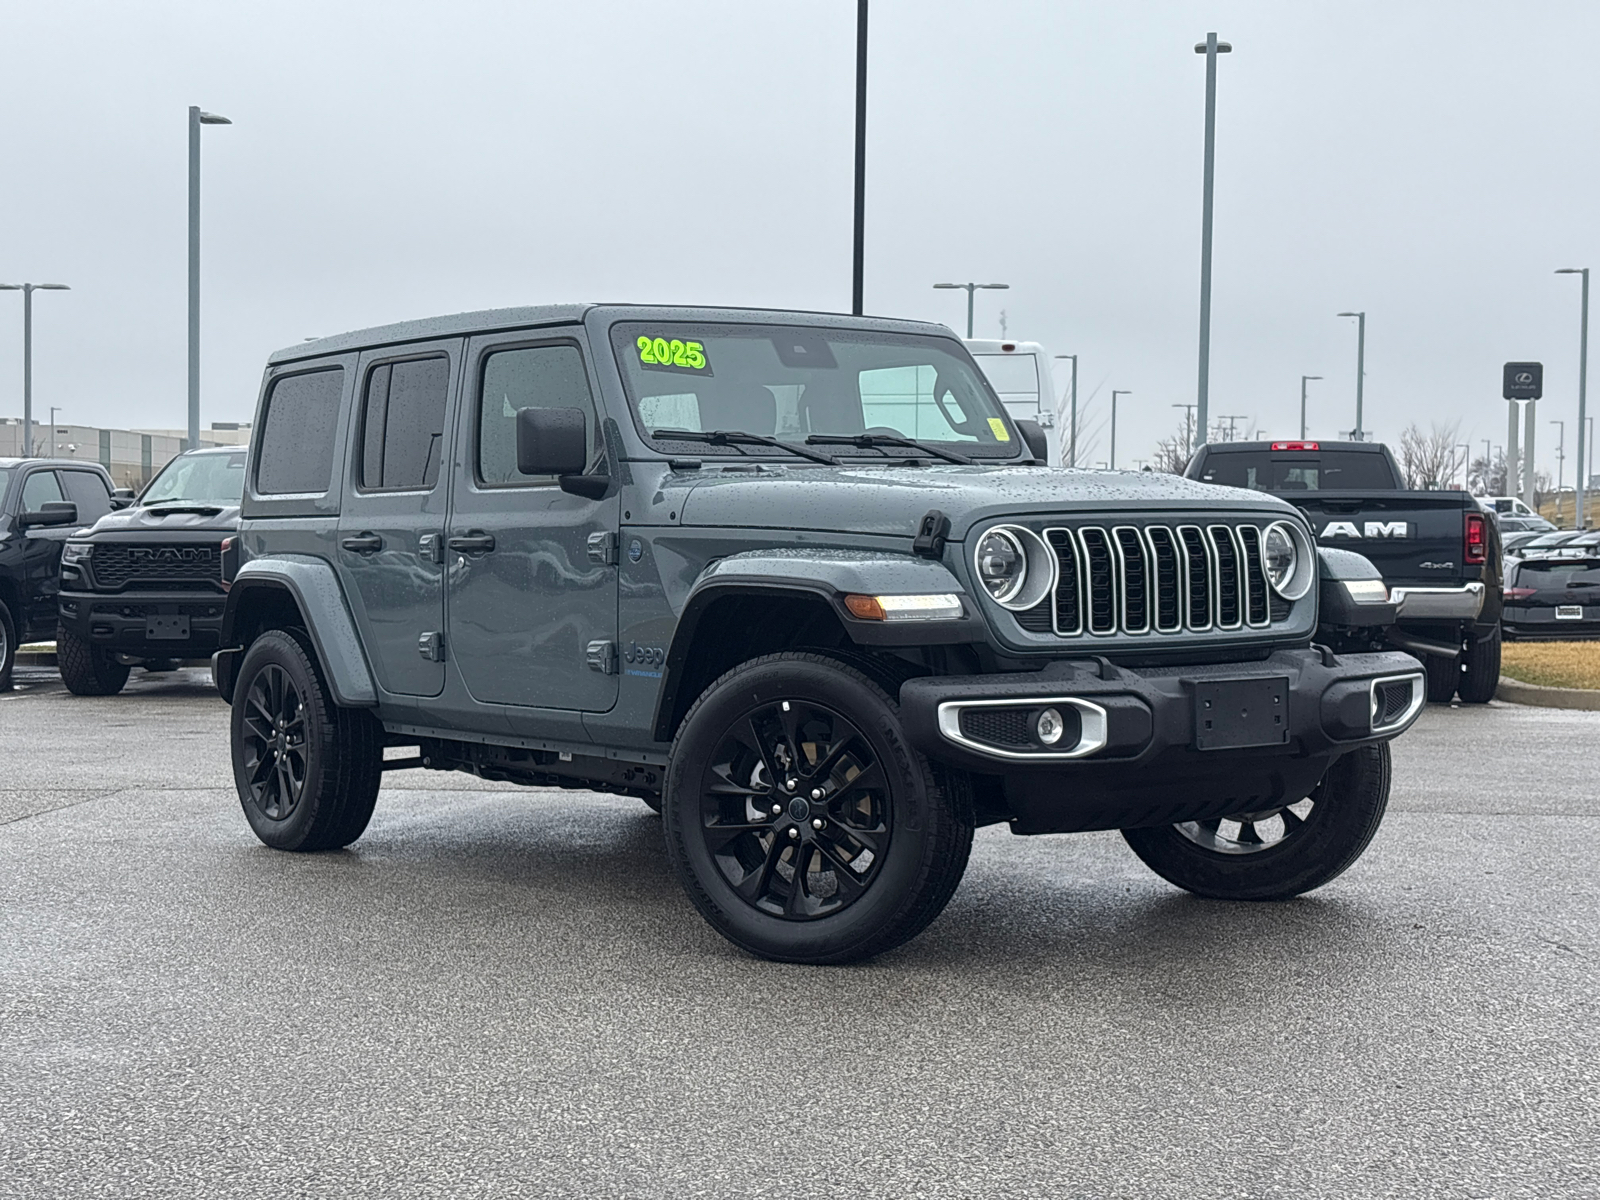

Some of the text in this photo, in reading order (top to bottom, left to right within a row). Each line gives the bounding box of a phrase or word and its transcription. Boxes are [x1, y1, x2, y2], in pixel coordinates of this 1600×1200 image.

[637, 335, 706, 369] 2025
[1312, 521, 1408, 540] AM
[127, 547, 213, 560] RAM
[1419, 560, 1456, 570] 4x4
[624, 638, 665, 670] Jeep
